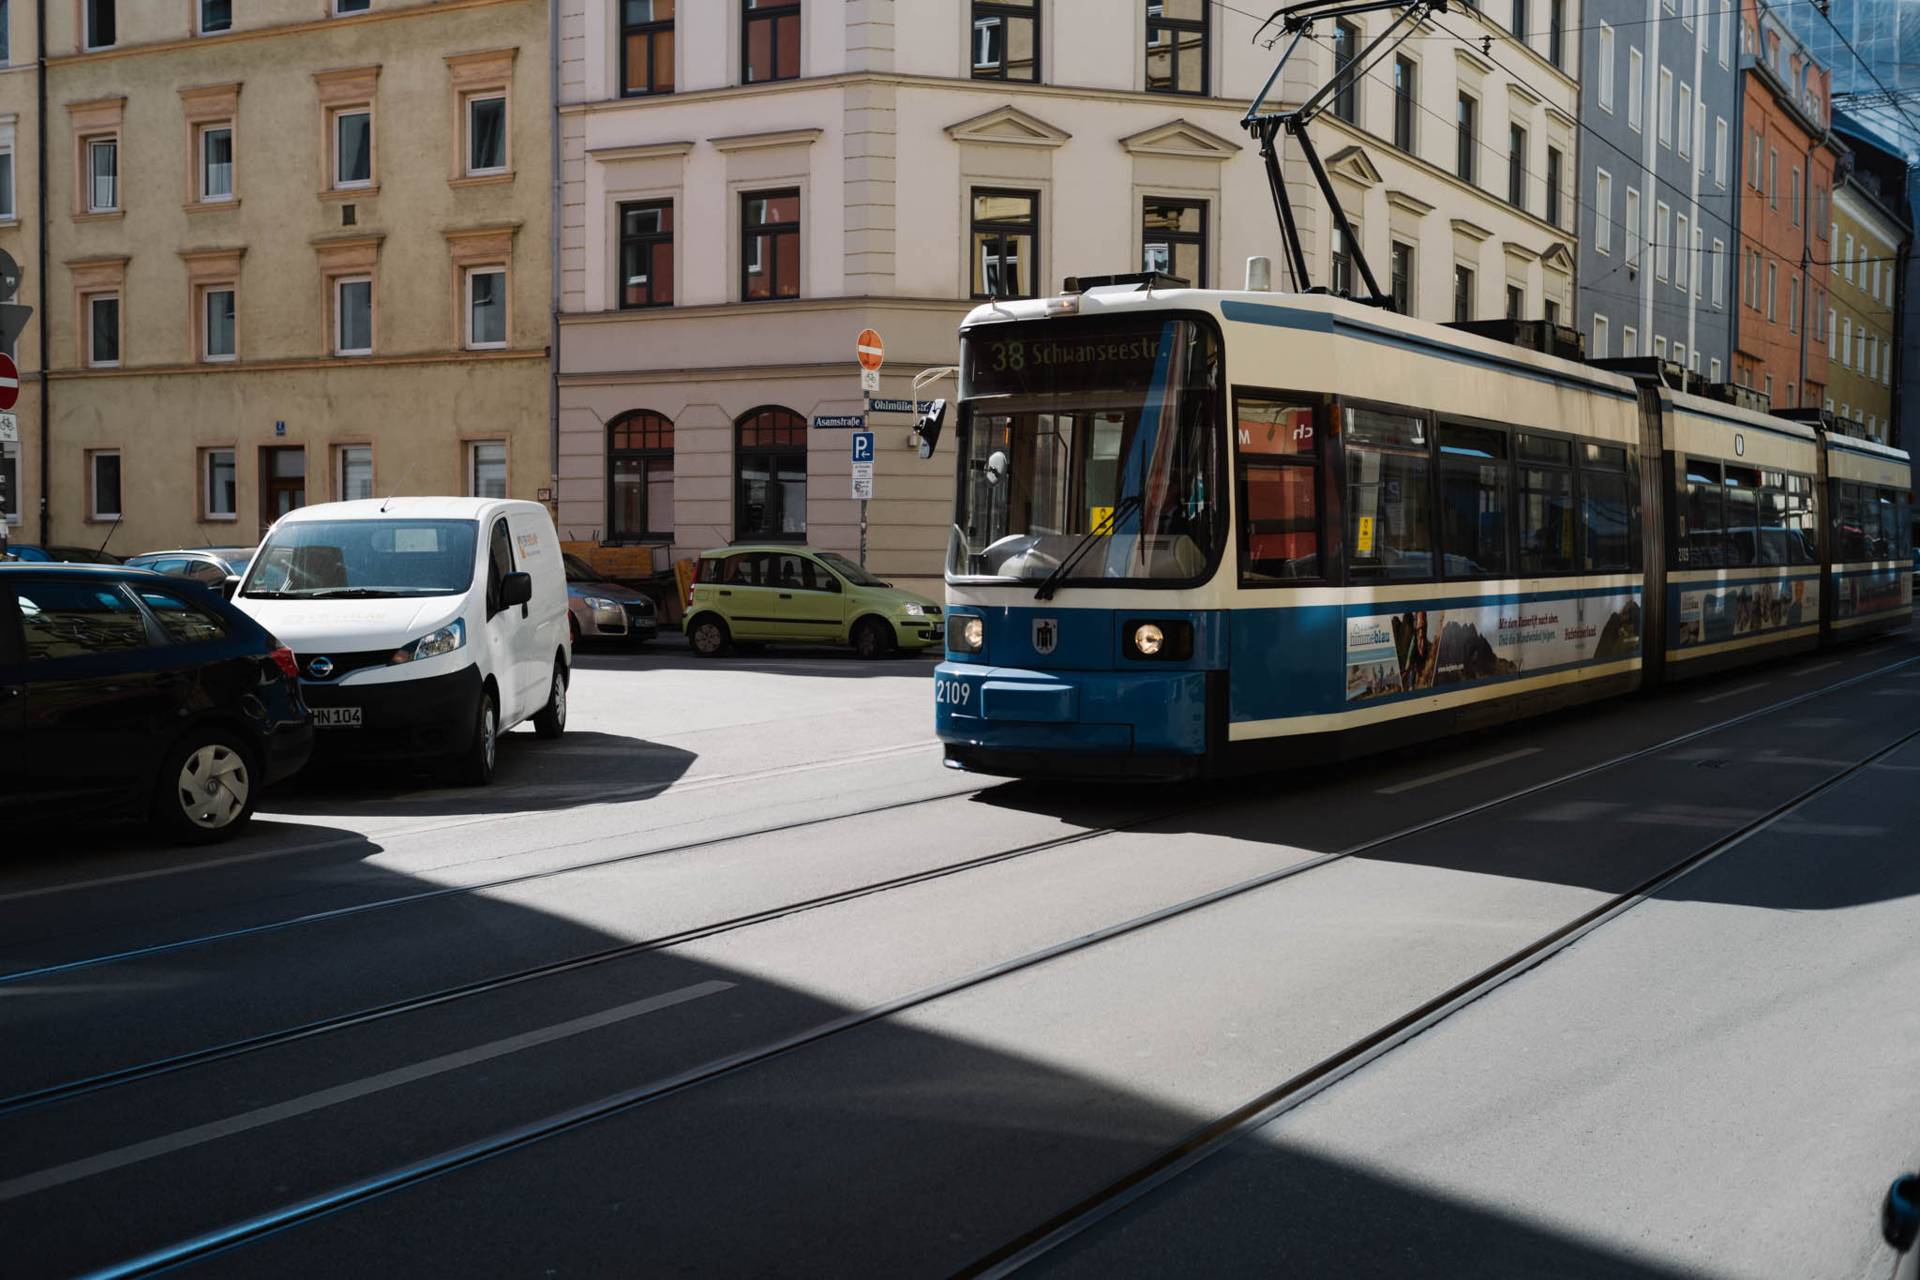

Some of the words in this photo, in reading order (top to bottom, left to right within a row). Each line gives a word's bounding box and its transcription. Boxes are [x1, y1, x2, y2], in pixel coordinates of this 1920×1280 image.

[991, 343, 1024, 370] 38
[874, 400, 929, 412] Ohlmülletr.
[816, 417, 860, 427] Asamstraße
[855, 436, 868, 459] P
[937, 680, 970, 706] 2109
[333, 709, 361, 723] 104
